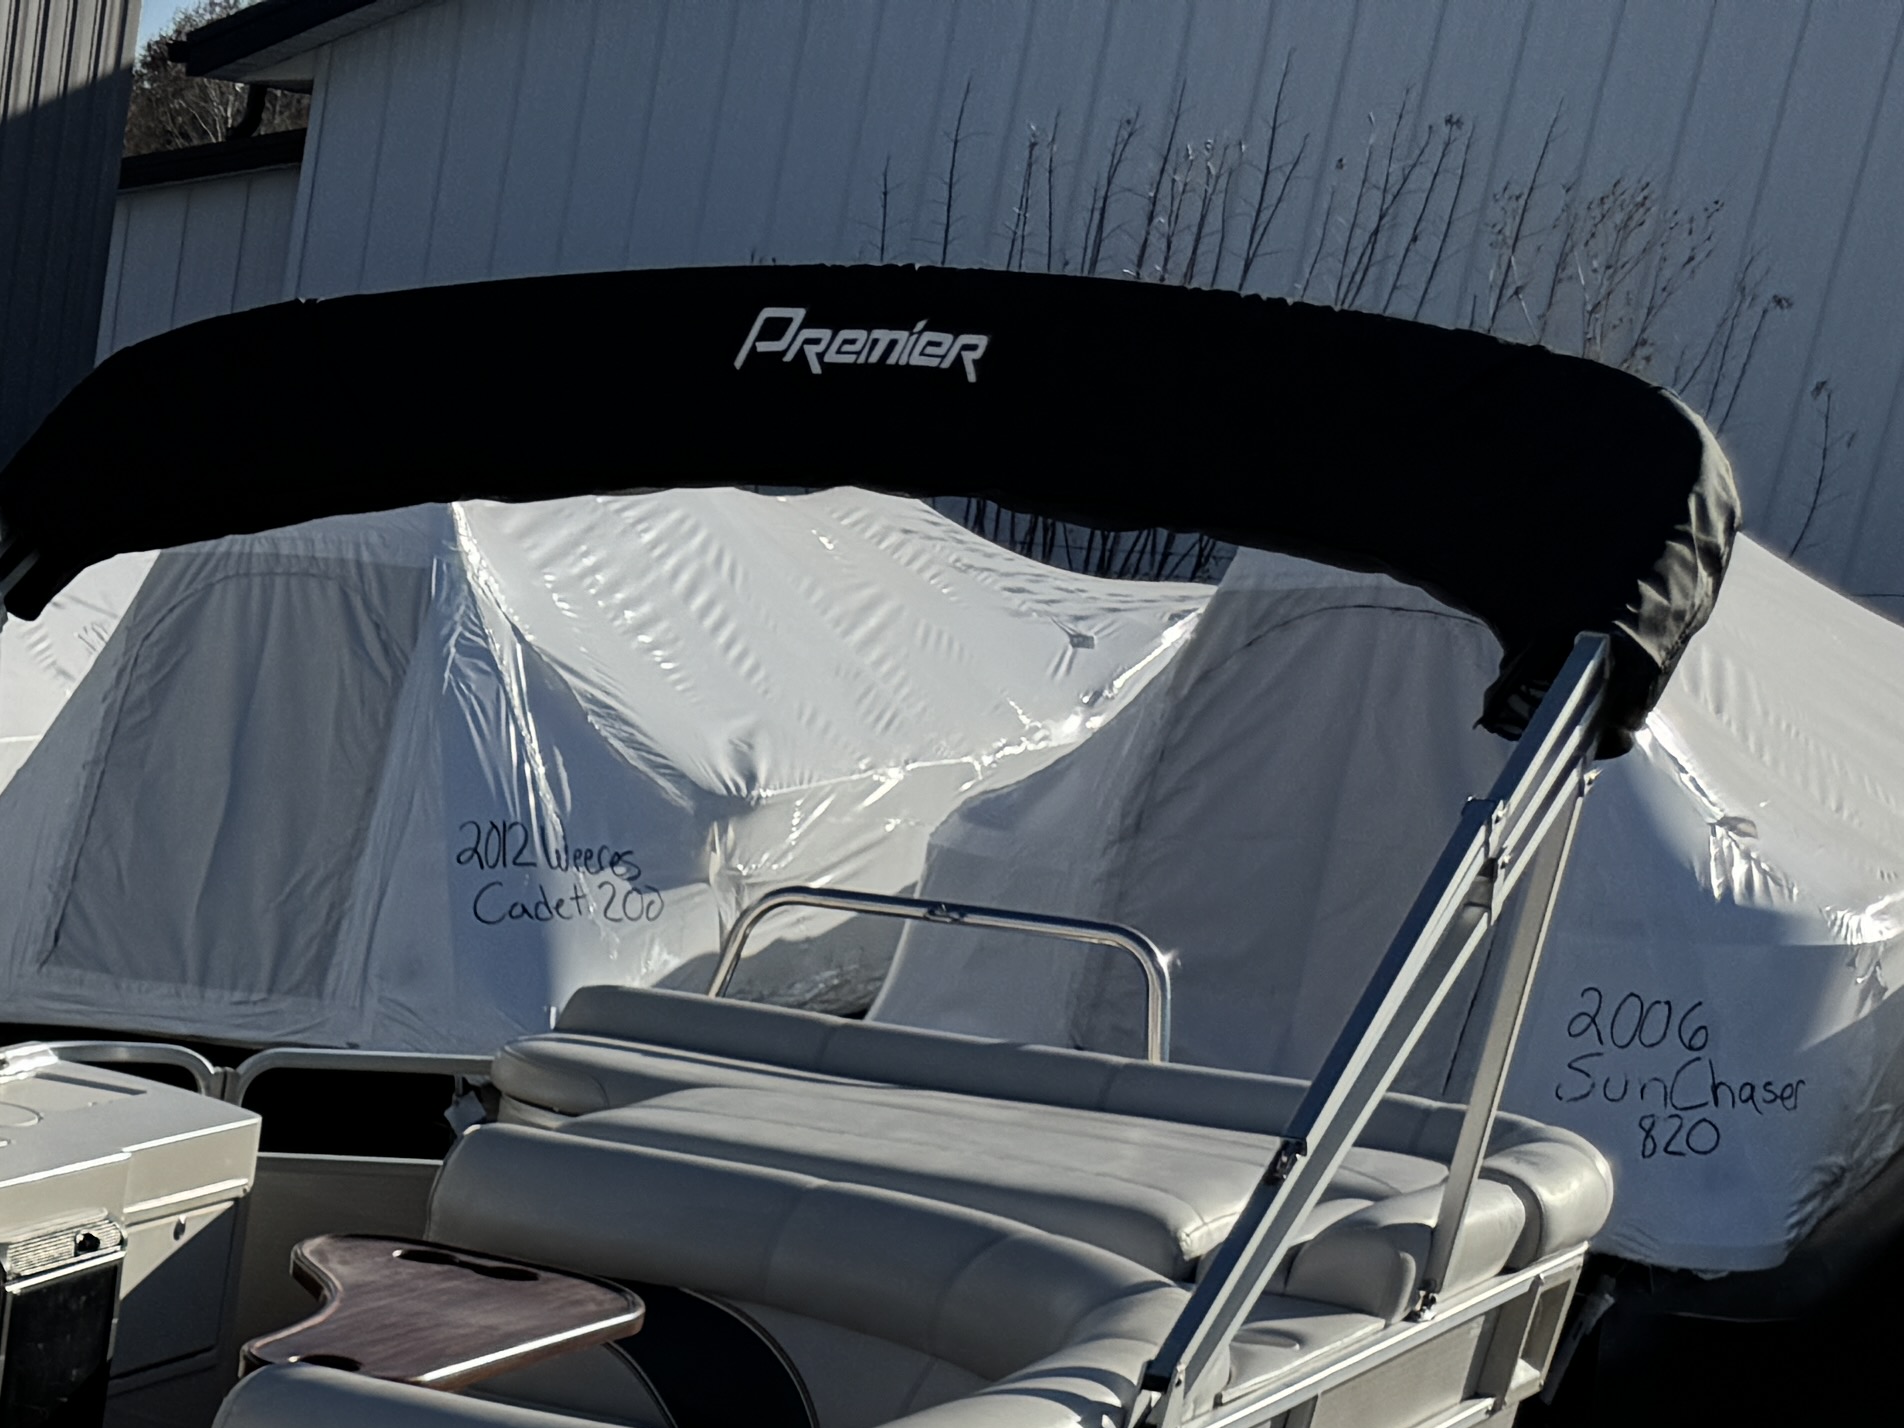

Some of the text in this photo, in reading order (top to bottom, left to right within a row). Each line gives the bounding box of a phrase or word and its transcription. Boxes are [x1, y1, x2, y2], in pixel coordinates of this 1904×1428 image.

[456, 820, 537, 870] 2012
[473, 881, 665, 924] Cadet 200
[1567, 986, 1709, 1051] 2006
[1638, 1114, 1721, 1159] 820
